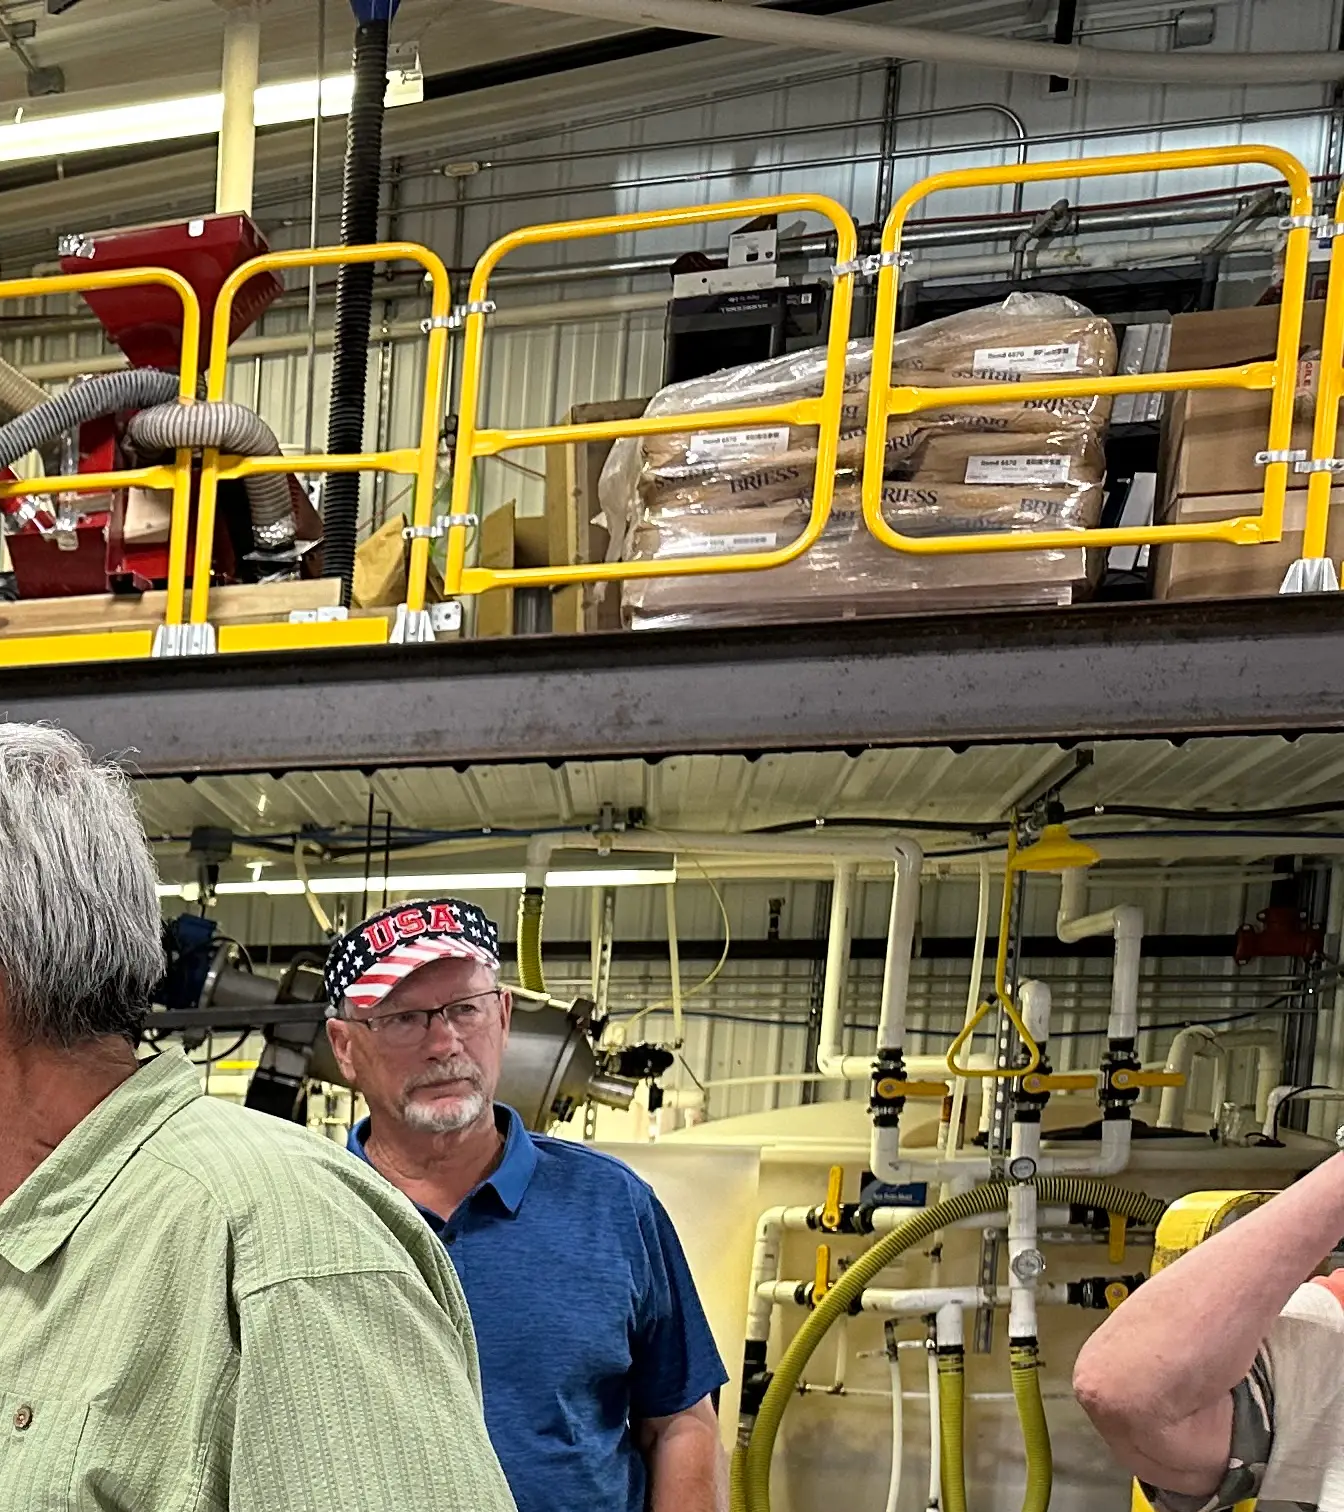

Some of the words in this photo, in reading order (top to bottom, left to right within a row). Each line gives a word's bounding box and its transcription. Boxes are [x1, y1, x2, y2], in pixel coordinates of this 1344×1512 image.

[729, 465, 800, 494] BRIESS
[882, 487, 939, 506] RIESS
[360, 902, 466, 955] USA
